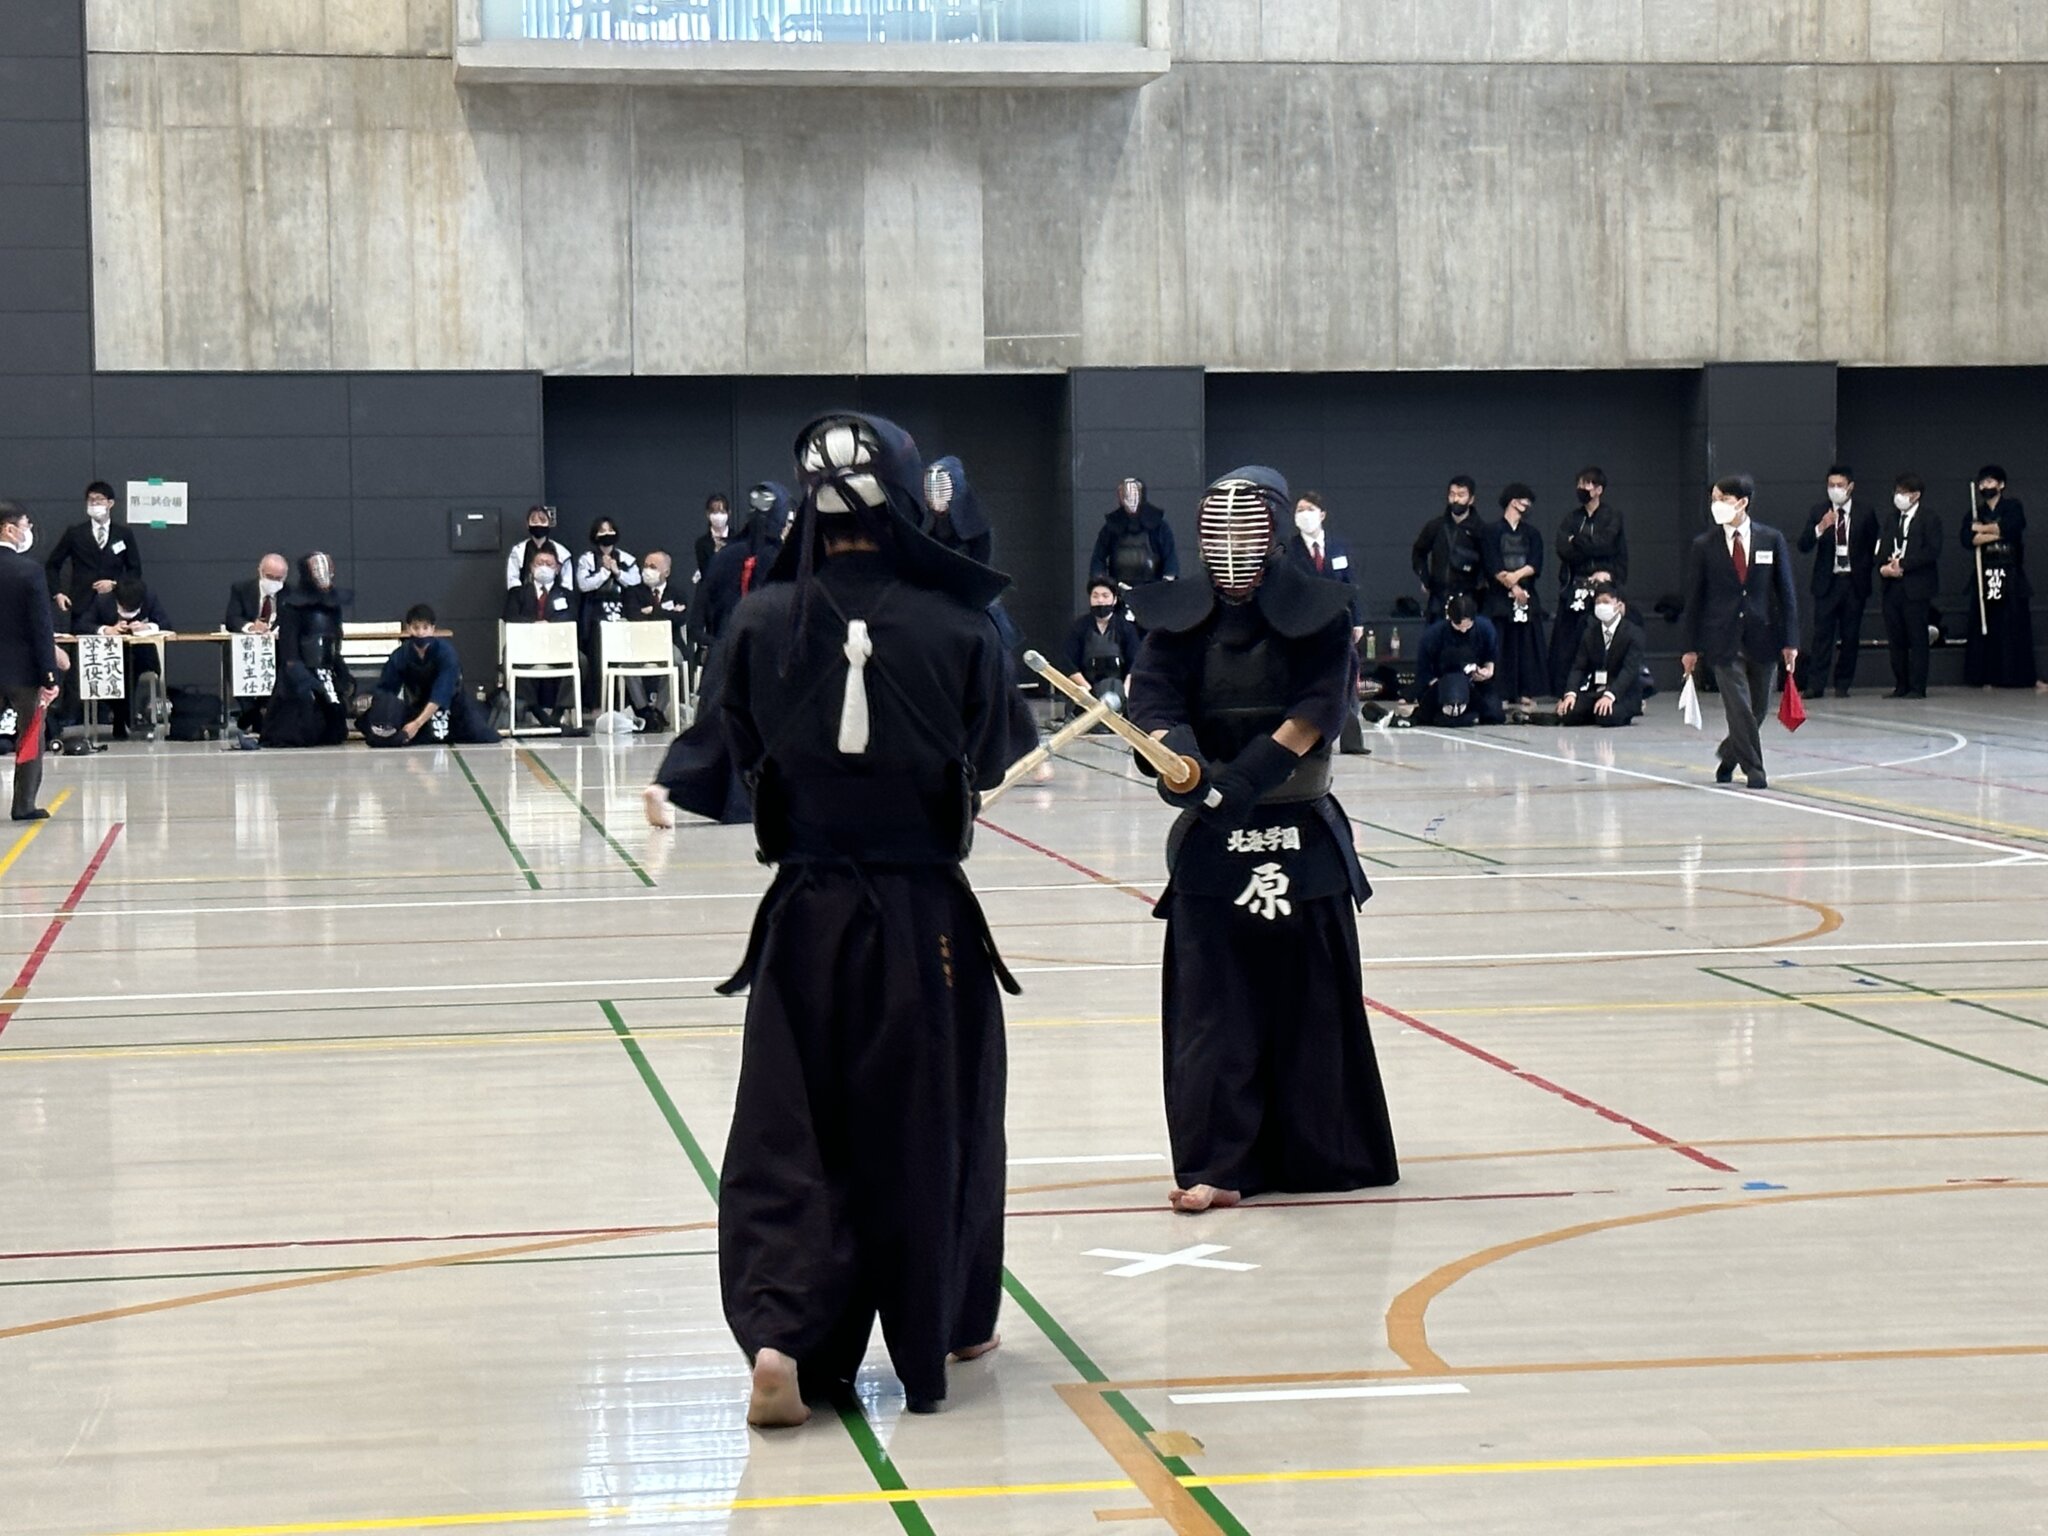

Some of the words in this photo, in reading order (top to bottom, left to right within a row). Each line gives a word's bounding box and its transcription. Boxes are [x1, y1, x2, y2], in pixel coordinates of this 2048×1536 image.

[130, 495, 183, 507] 第二試合場
[241, 636, 258, 693] 審判主任
[1226, 825, 1301, 852] 北海学園
[1234, 862, 1292, 920] 原
